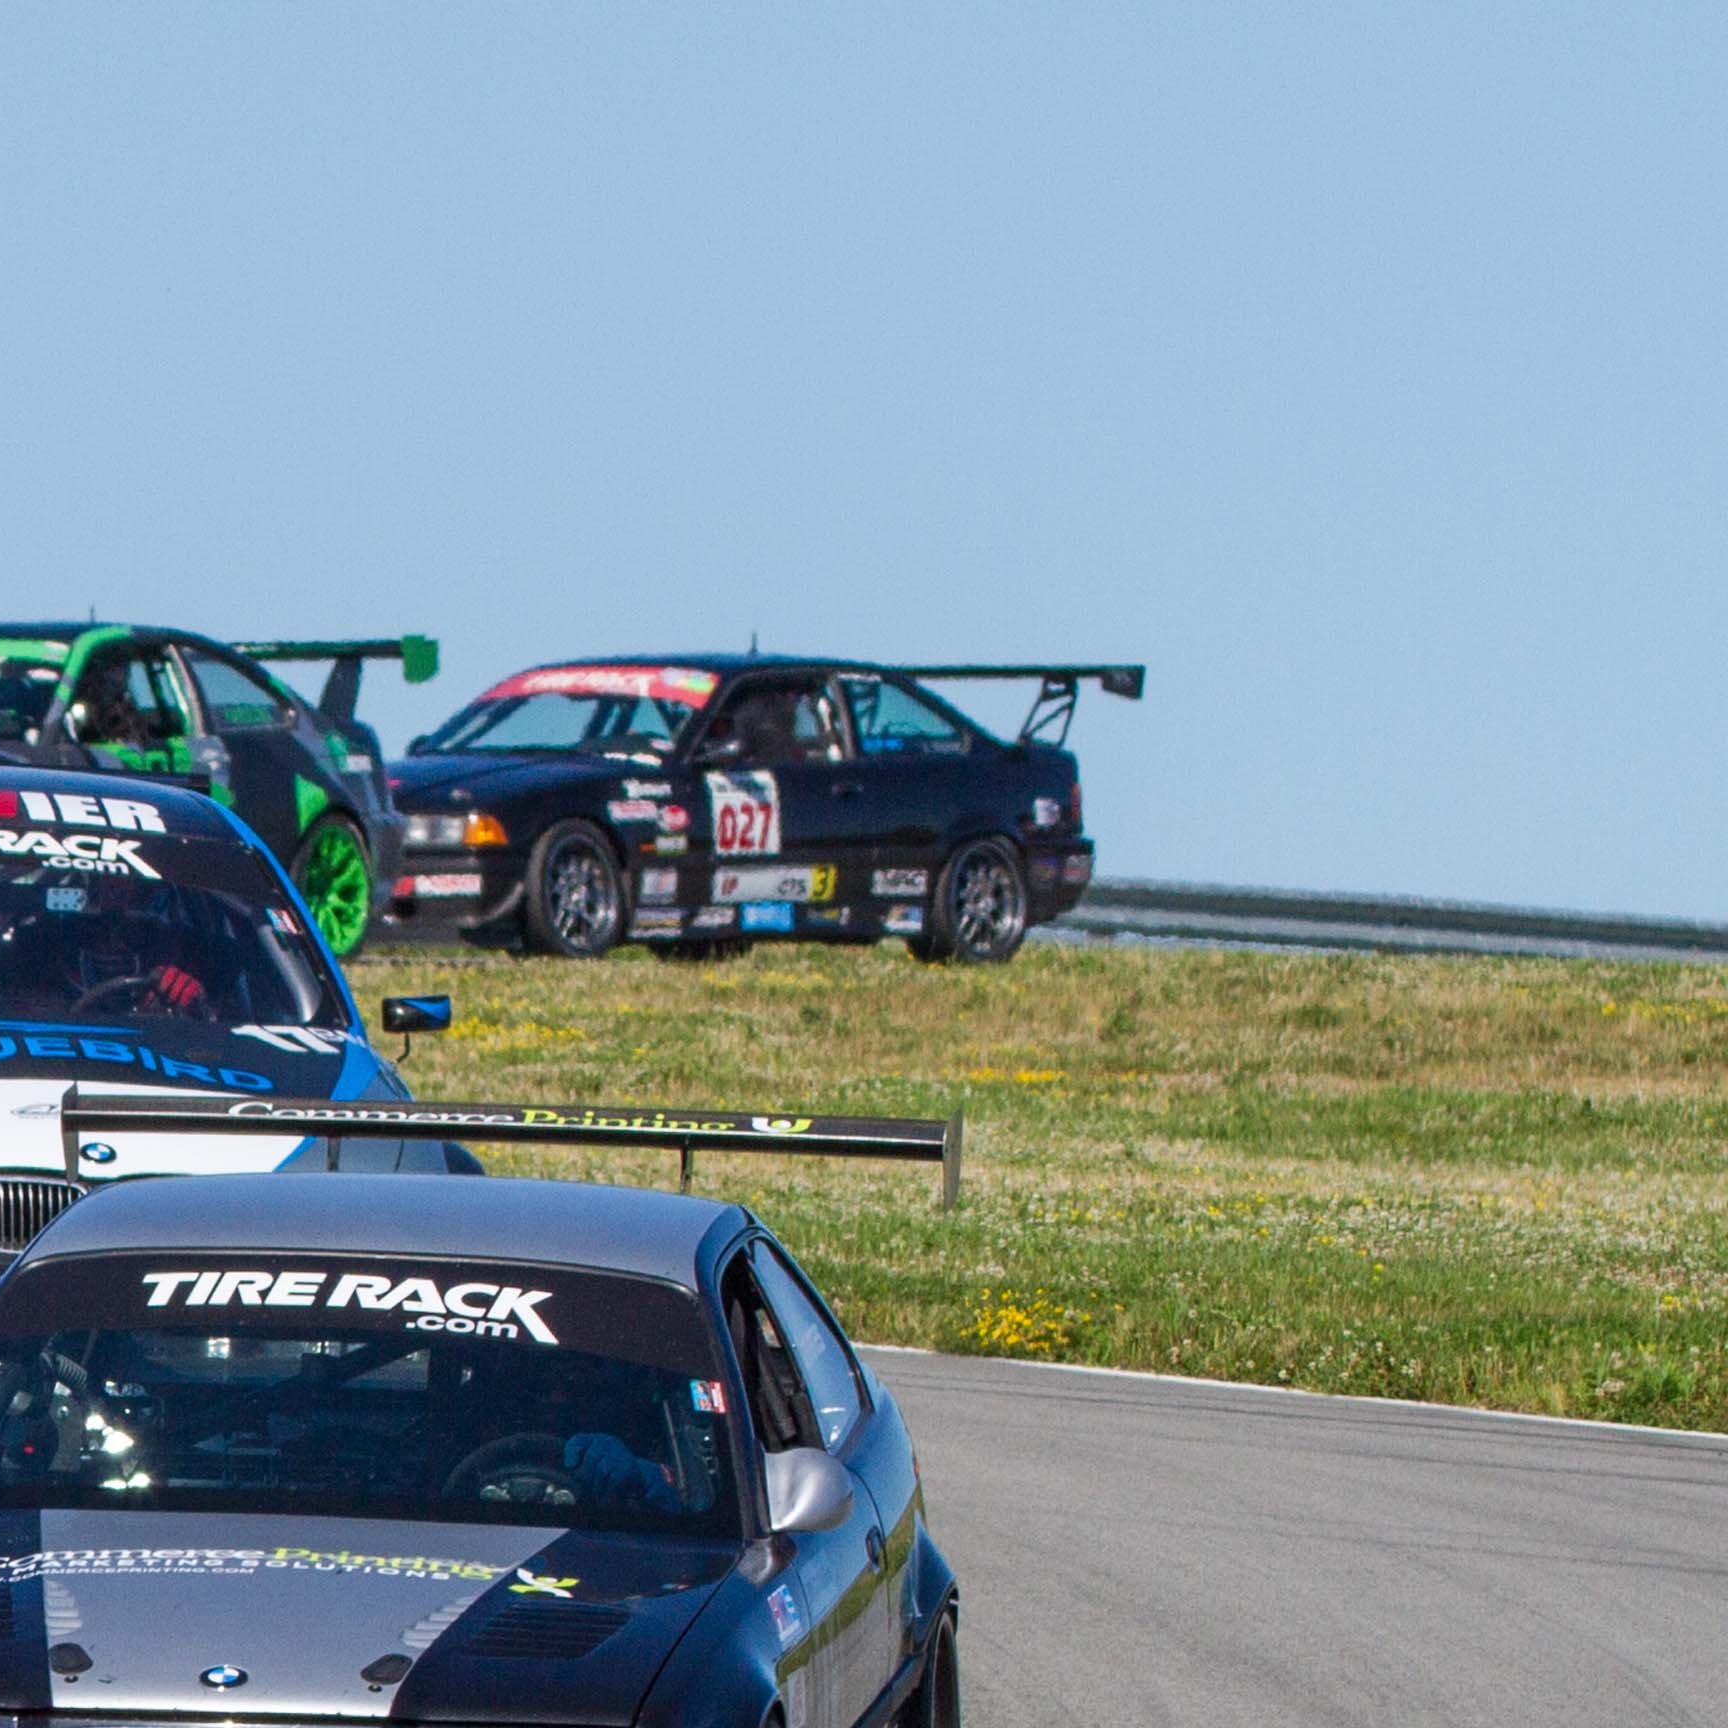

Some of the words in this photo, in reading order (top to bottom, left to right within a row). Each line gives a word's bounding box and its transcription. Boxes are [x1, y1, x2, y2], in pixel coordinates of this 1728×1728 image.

[718, 803, 773, 850] 027
[41, 859, 129, 875] .com
[230, 1024, 341, 1052] 17
[142, 1271, 330, 1307] TIRE
[325, 1273, 561, 1345] RACK
[405, 1315, 519, 1339] .com
[12, 1559, 225, 1577] MARKETING
[240, 1559, 451, 1581] SOLUTIONS
[273, 1547, 493, 1580] Printing
